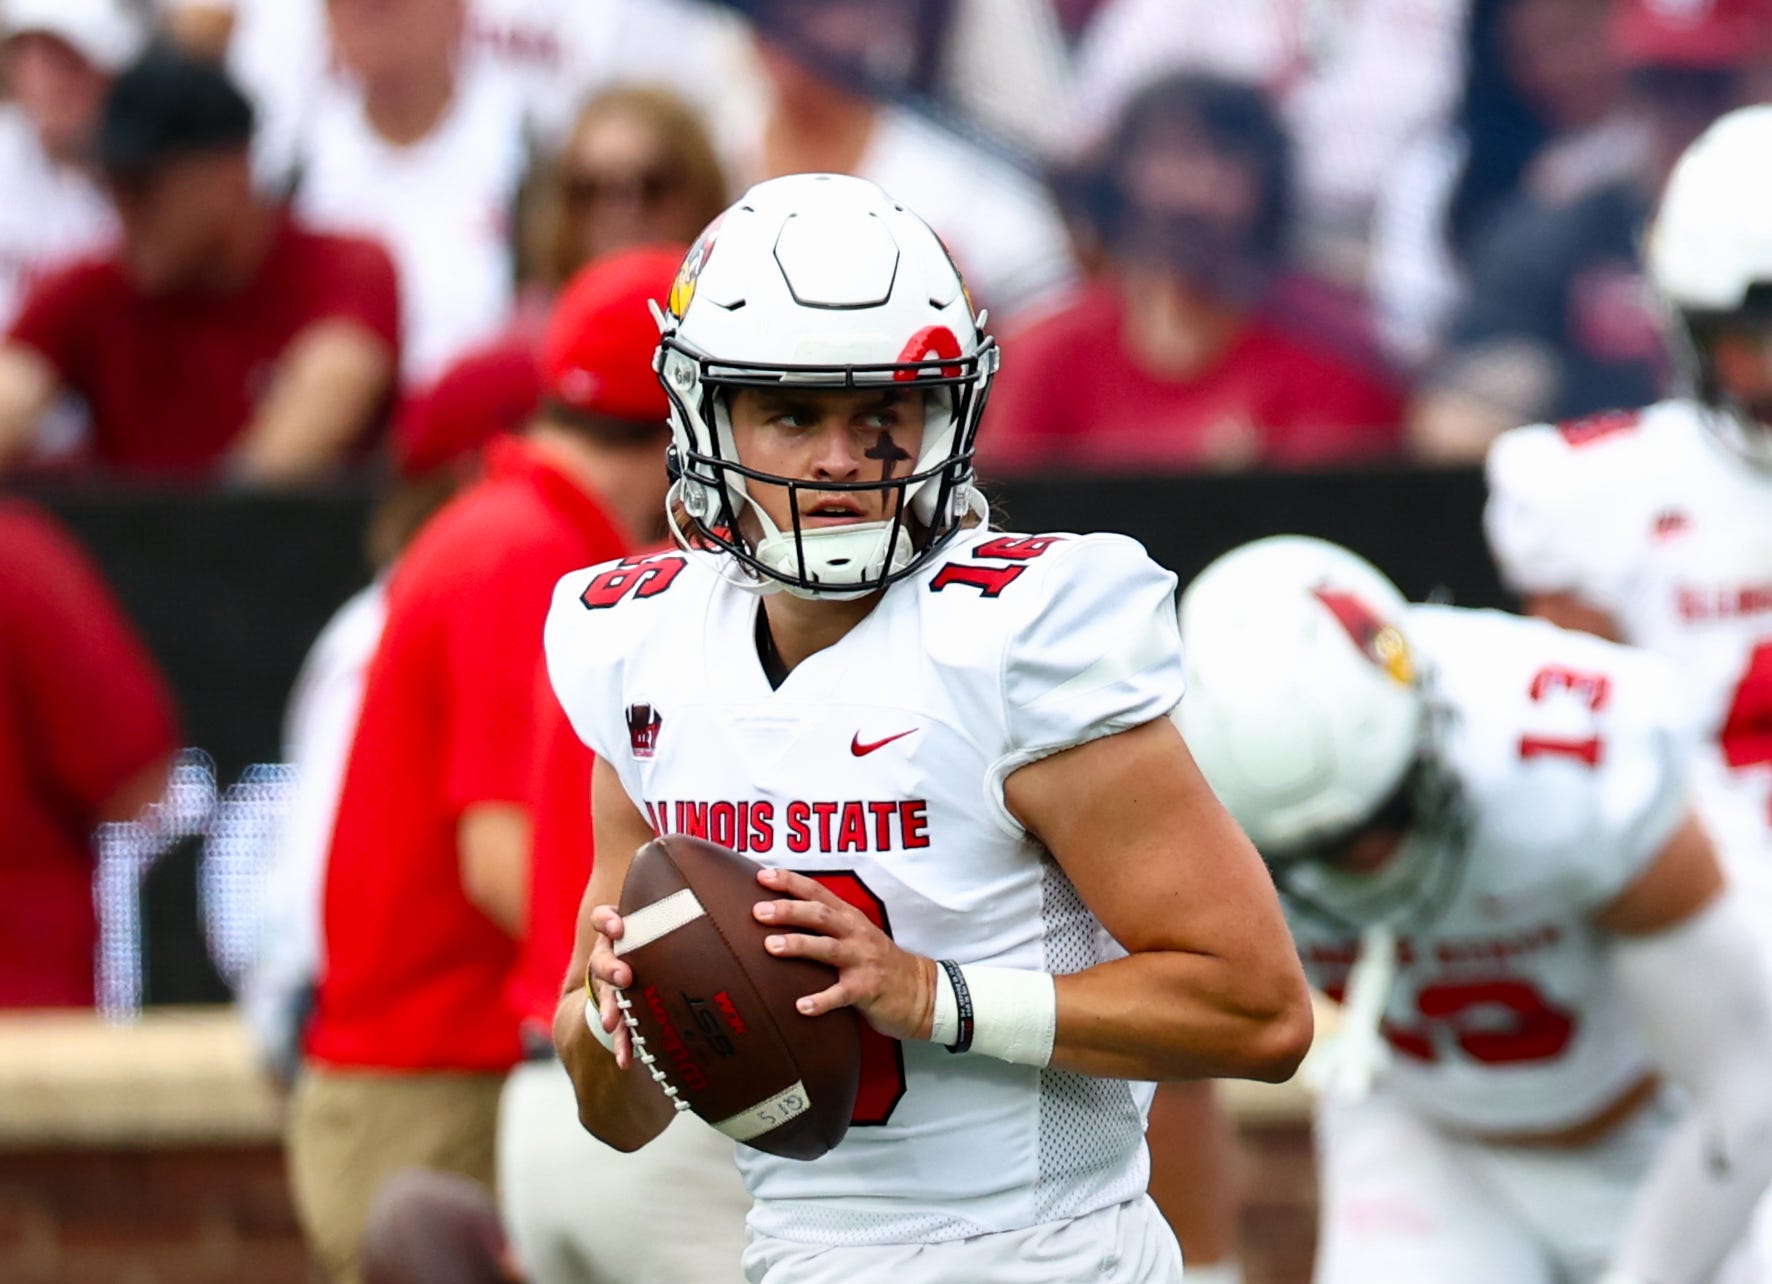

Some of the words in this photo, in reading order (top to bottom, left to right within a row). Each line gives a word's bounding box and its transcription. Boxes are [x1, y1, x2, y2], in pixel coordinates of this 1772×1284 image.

[929, 536, 1055, 598] 16
[1518, 663, 1612, 770] 13
[644, 800, 774, 853] LLINOIS
[787, 799, 930, 853] STATE
